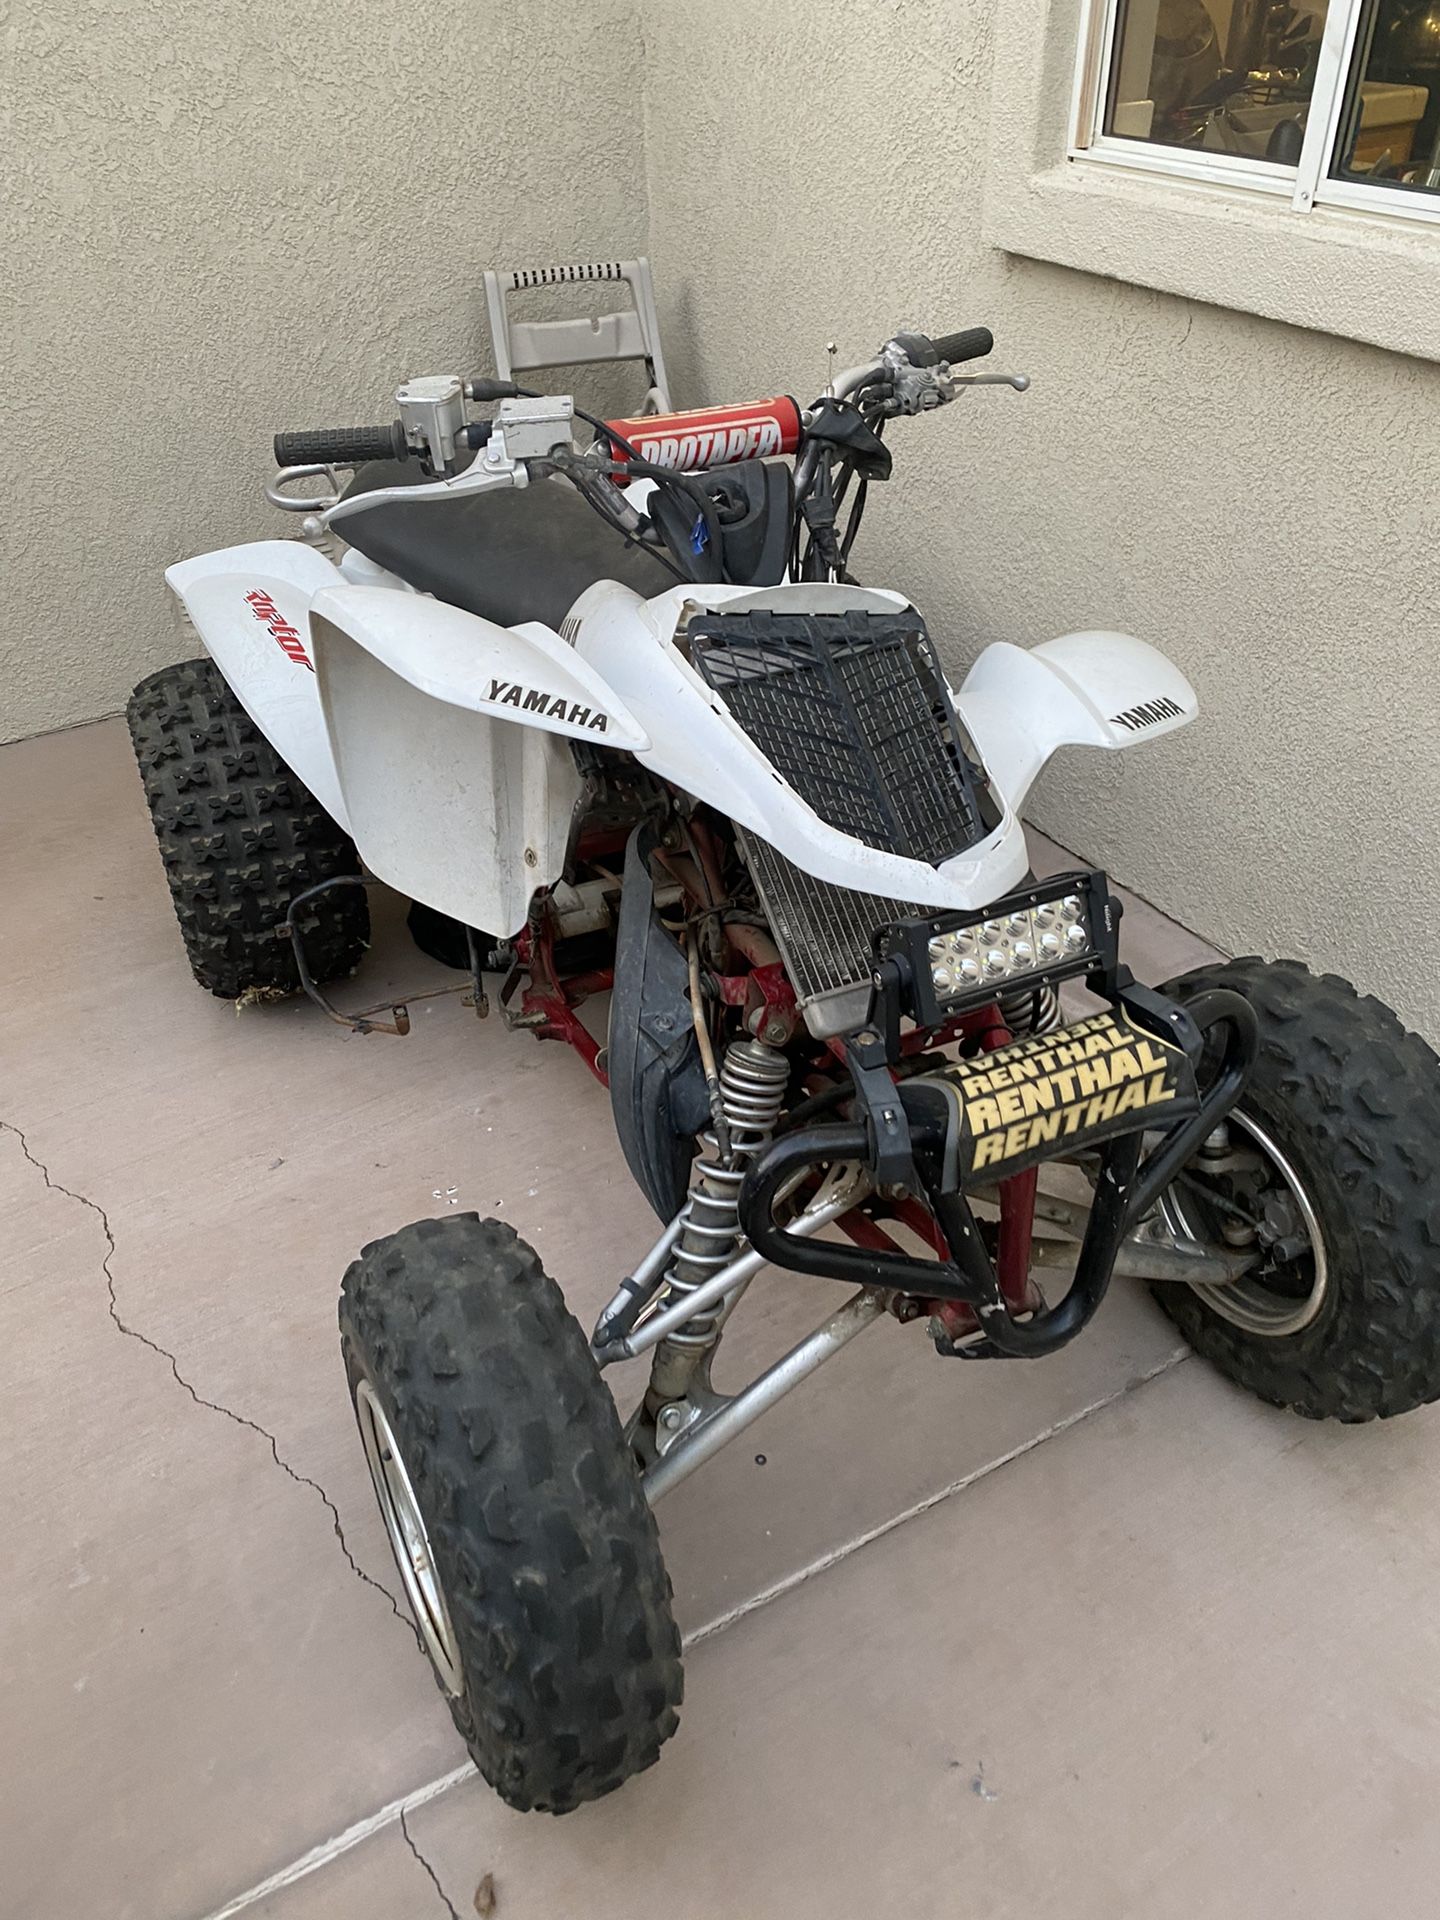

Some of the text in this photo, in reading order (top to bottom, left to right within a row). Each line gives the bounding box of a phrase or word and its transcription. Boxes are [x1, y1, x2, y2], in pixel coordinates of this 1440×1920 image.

[488, 679, 608, 732] YAMAHA
[1109, 697, 1186, 731] YAMAHA
[945, 1014, 1116, 1076] RENTHAL
[961, 1027, 1135, 1099] RENTHAL
[965, 1040, 1168, 1136] RENTHAL
[971, 1072, 1176, 1172] RENTHAL
